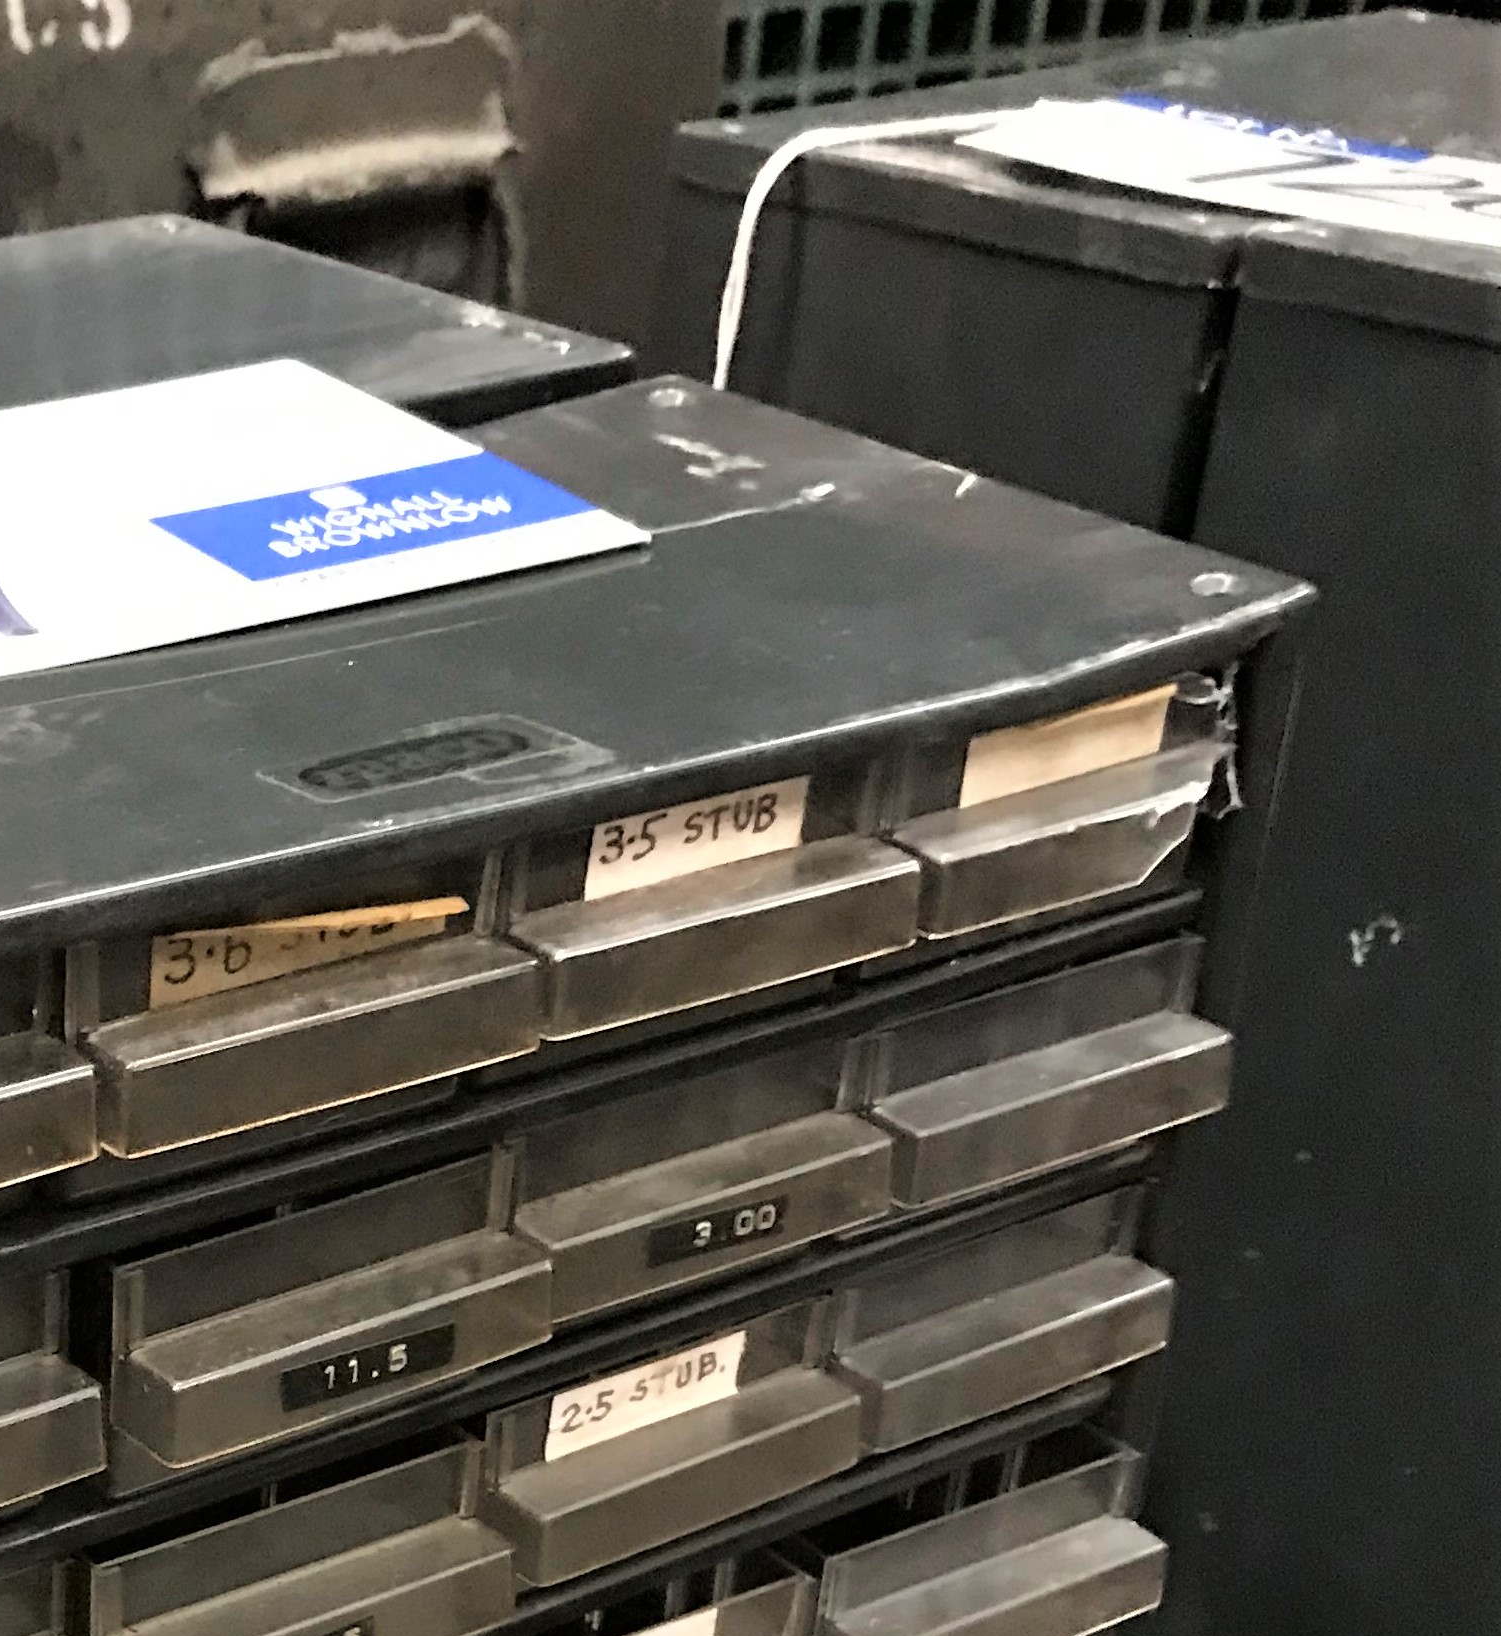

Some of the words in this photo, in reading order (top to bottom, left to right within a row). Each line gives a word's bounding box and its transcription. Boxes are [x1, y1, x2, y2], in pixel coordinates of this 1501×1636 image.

[268, 496, 511, 558] BROWNLOW
[684, 794, 778, 844] STUB
[324, 1343, 408, 1390] 11.5
